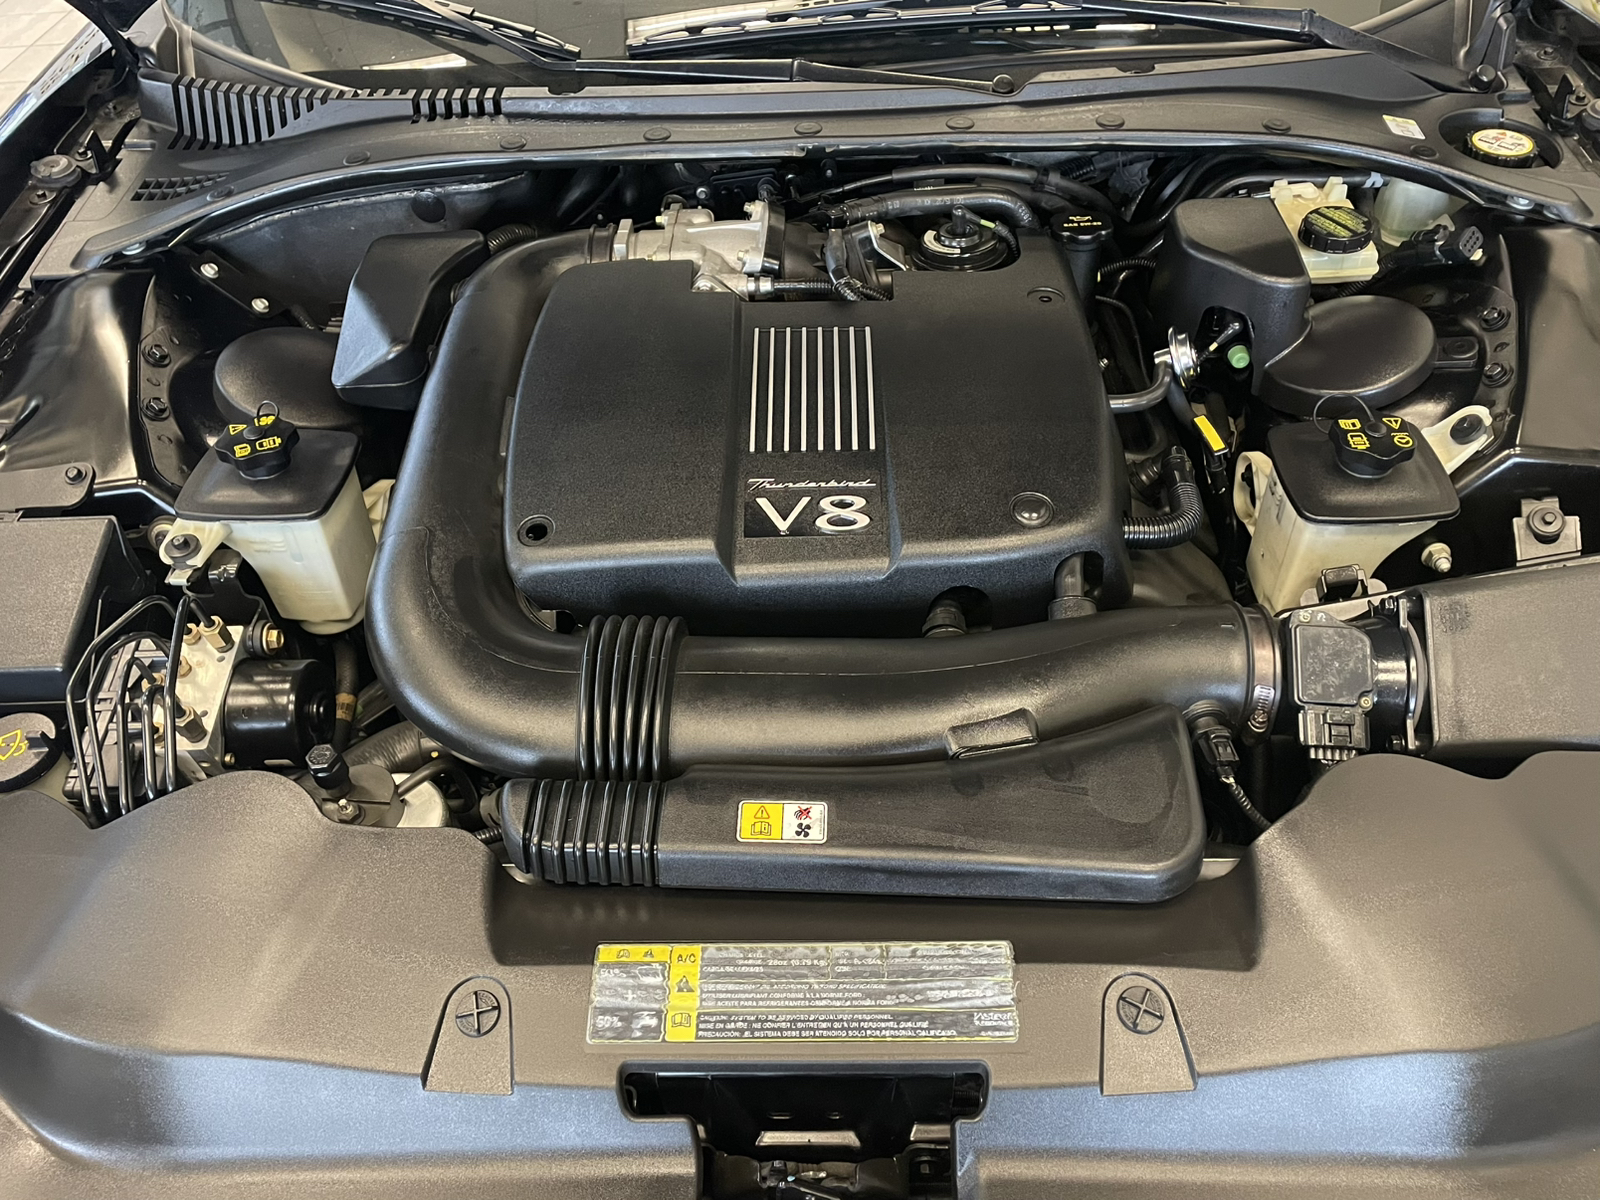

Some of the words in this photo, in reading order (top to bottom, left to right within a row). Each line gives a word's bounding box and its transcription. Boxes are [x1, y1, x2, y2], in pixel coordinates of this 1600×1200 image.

[747, 478, 876, 493] Thunderbird
[755, 495, 870, 534] V8
[676, 953, 697, 963] A/C
[596, 1016, 622, 1029] 50%
